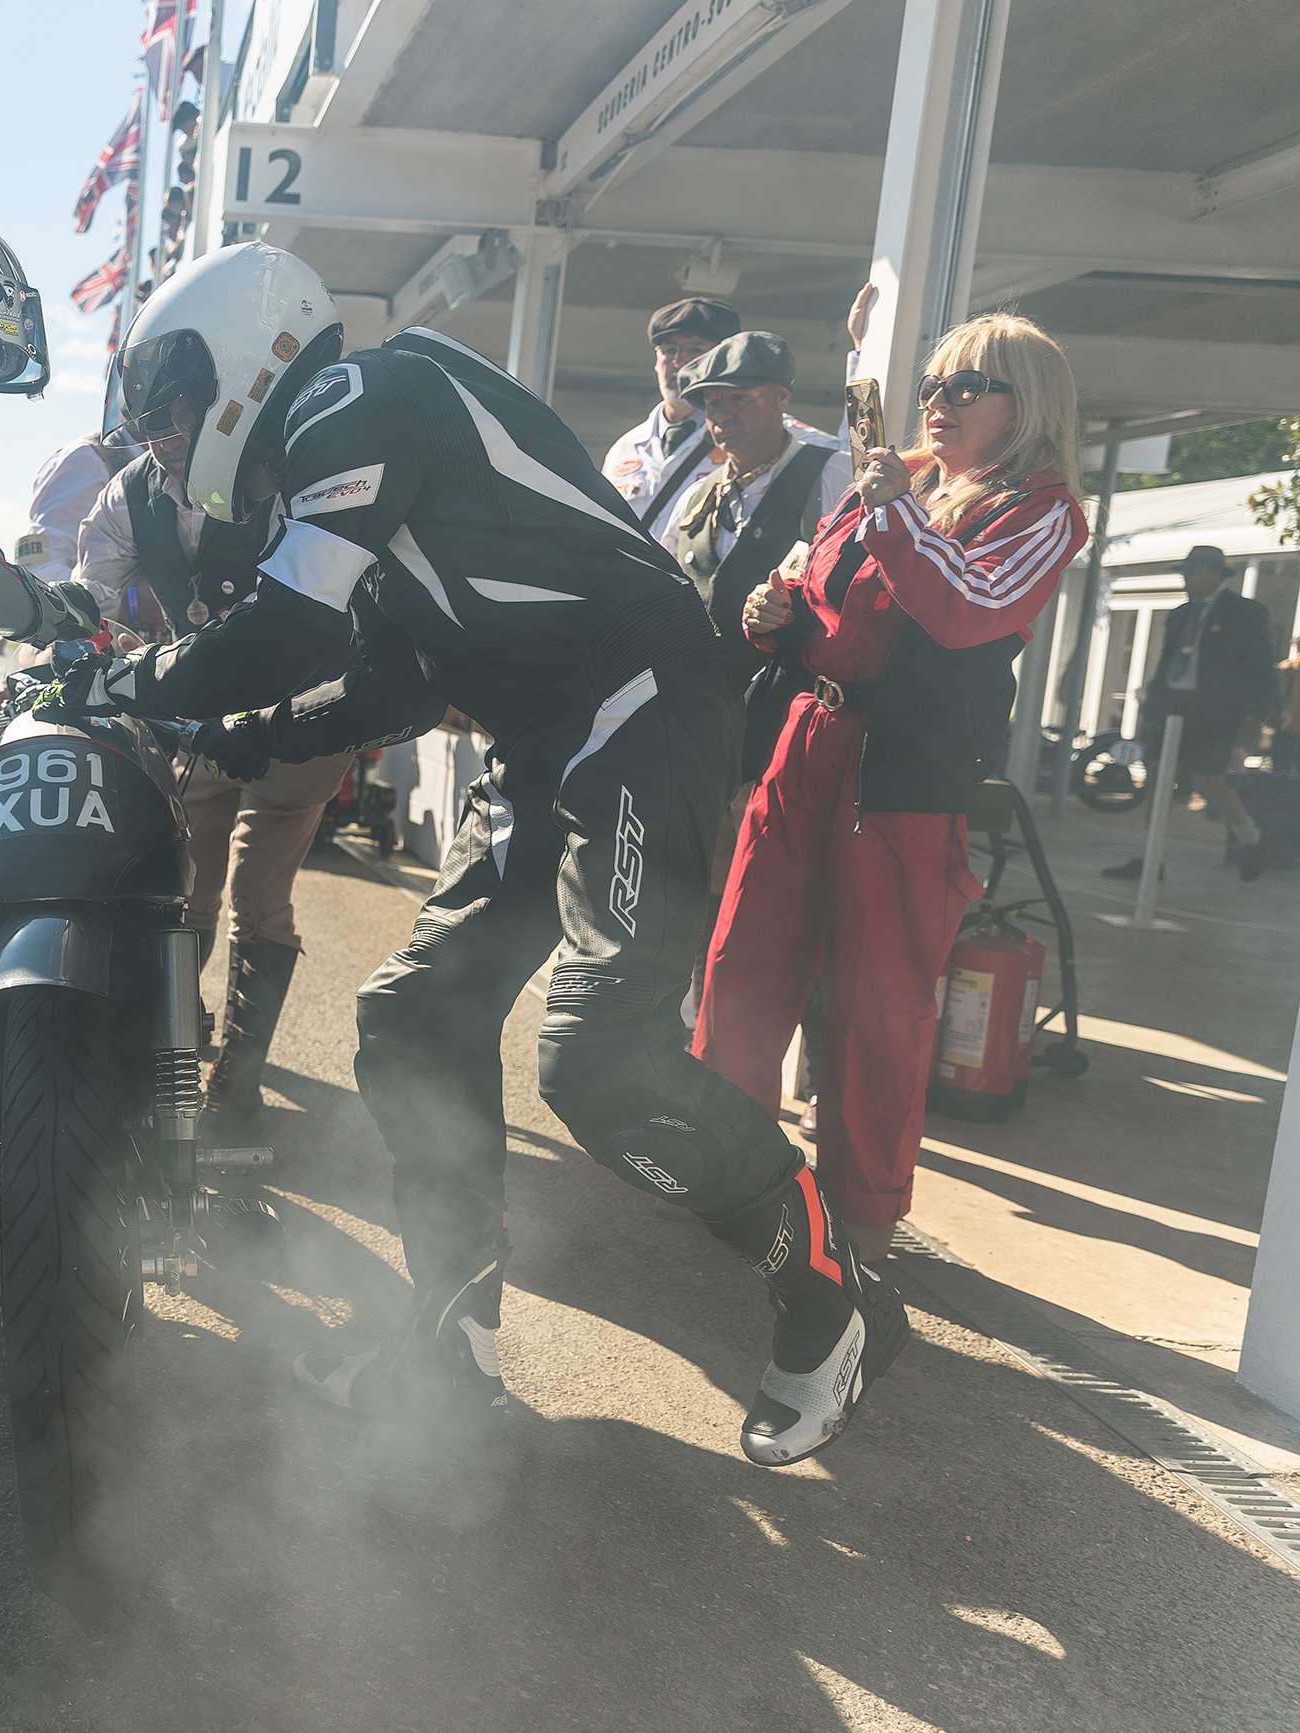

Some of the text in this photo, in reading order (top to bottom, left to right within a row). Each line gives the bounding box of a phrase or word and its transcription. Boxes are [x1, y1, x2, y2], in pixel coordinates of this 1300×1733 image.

[235, 147, 302, 205] 12
[608, 784, 645, 939] RST
[622, 1151, 689, 1194] RST
[752, 1202, 796, 1279] RST
[832, 1328, 861, 1408] RST
